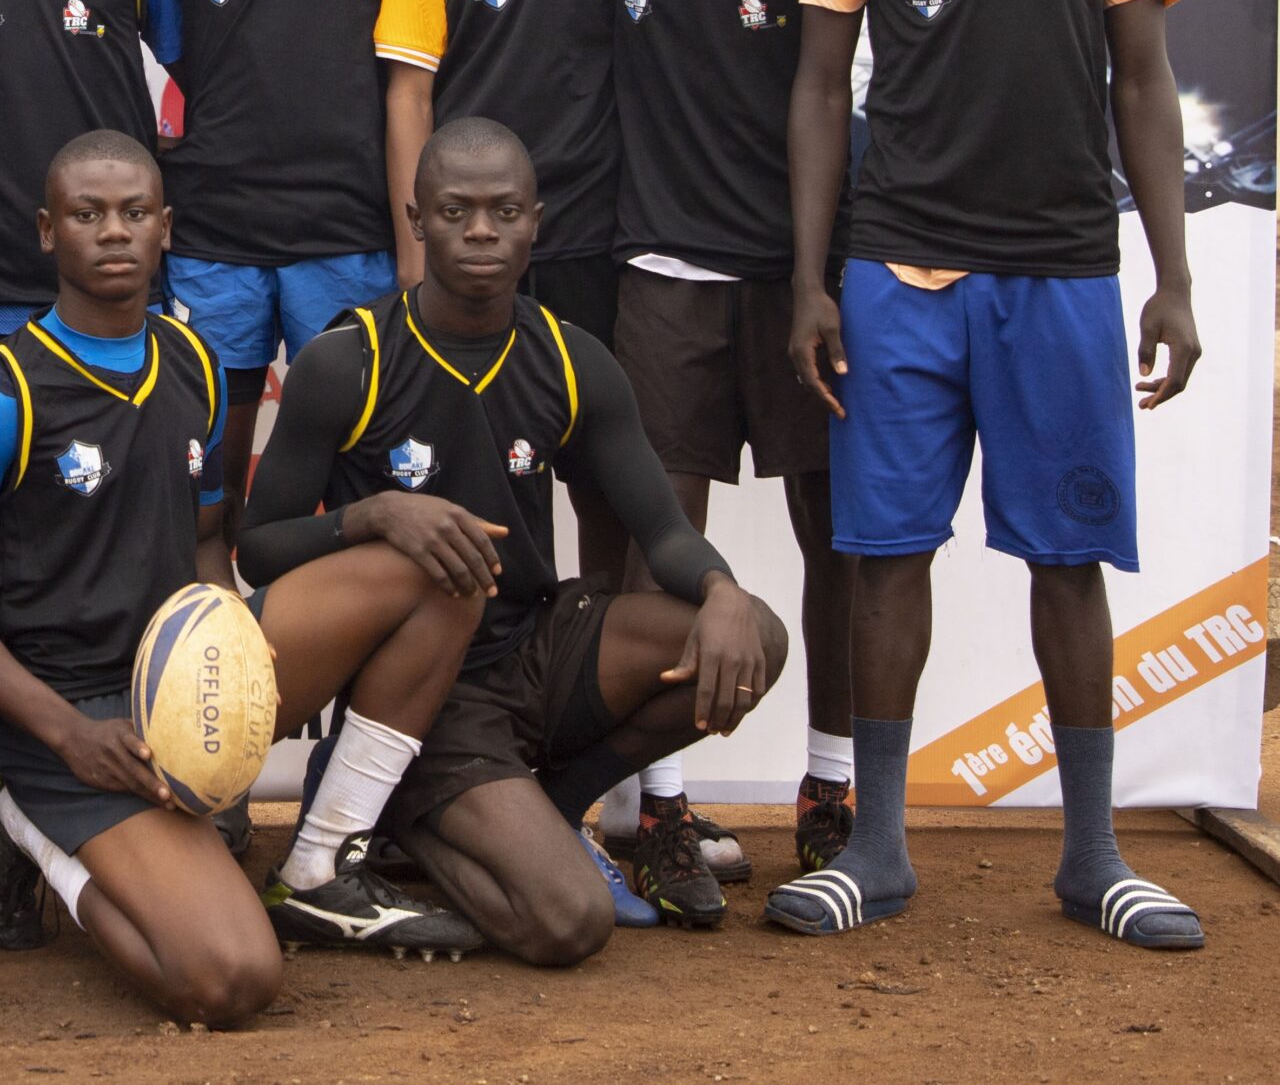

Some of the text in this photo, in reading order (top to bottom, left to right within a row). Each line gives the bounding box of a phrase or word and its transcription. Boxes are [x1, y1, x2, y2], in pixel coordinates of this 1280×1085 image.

[203, 646, 220, 754] OFFLOAD
[951, 604, 1265, 797] 1ère du TRC
